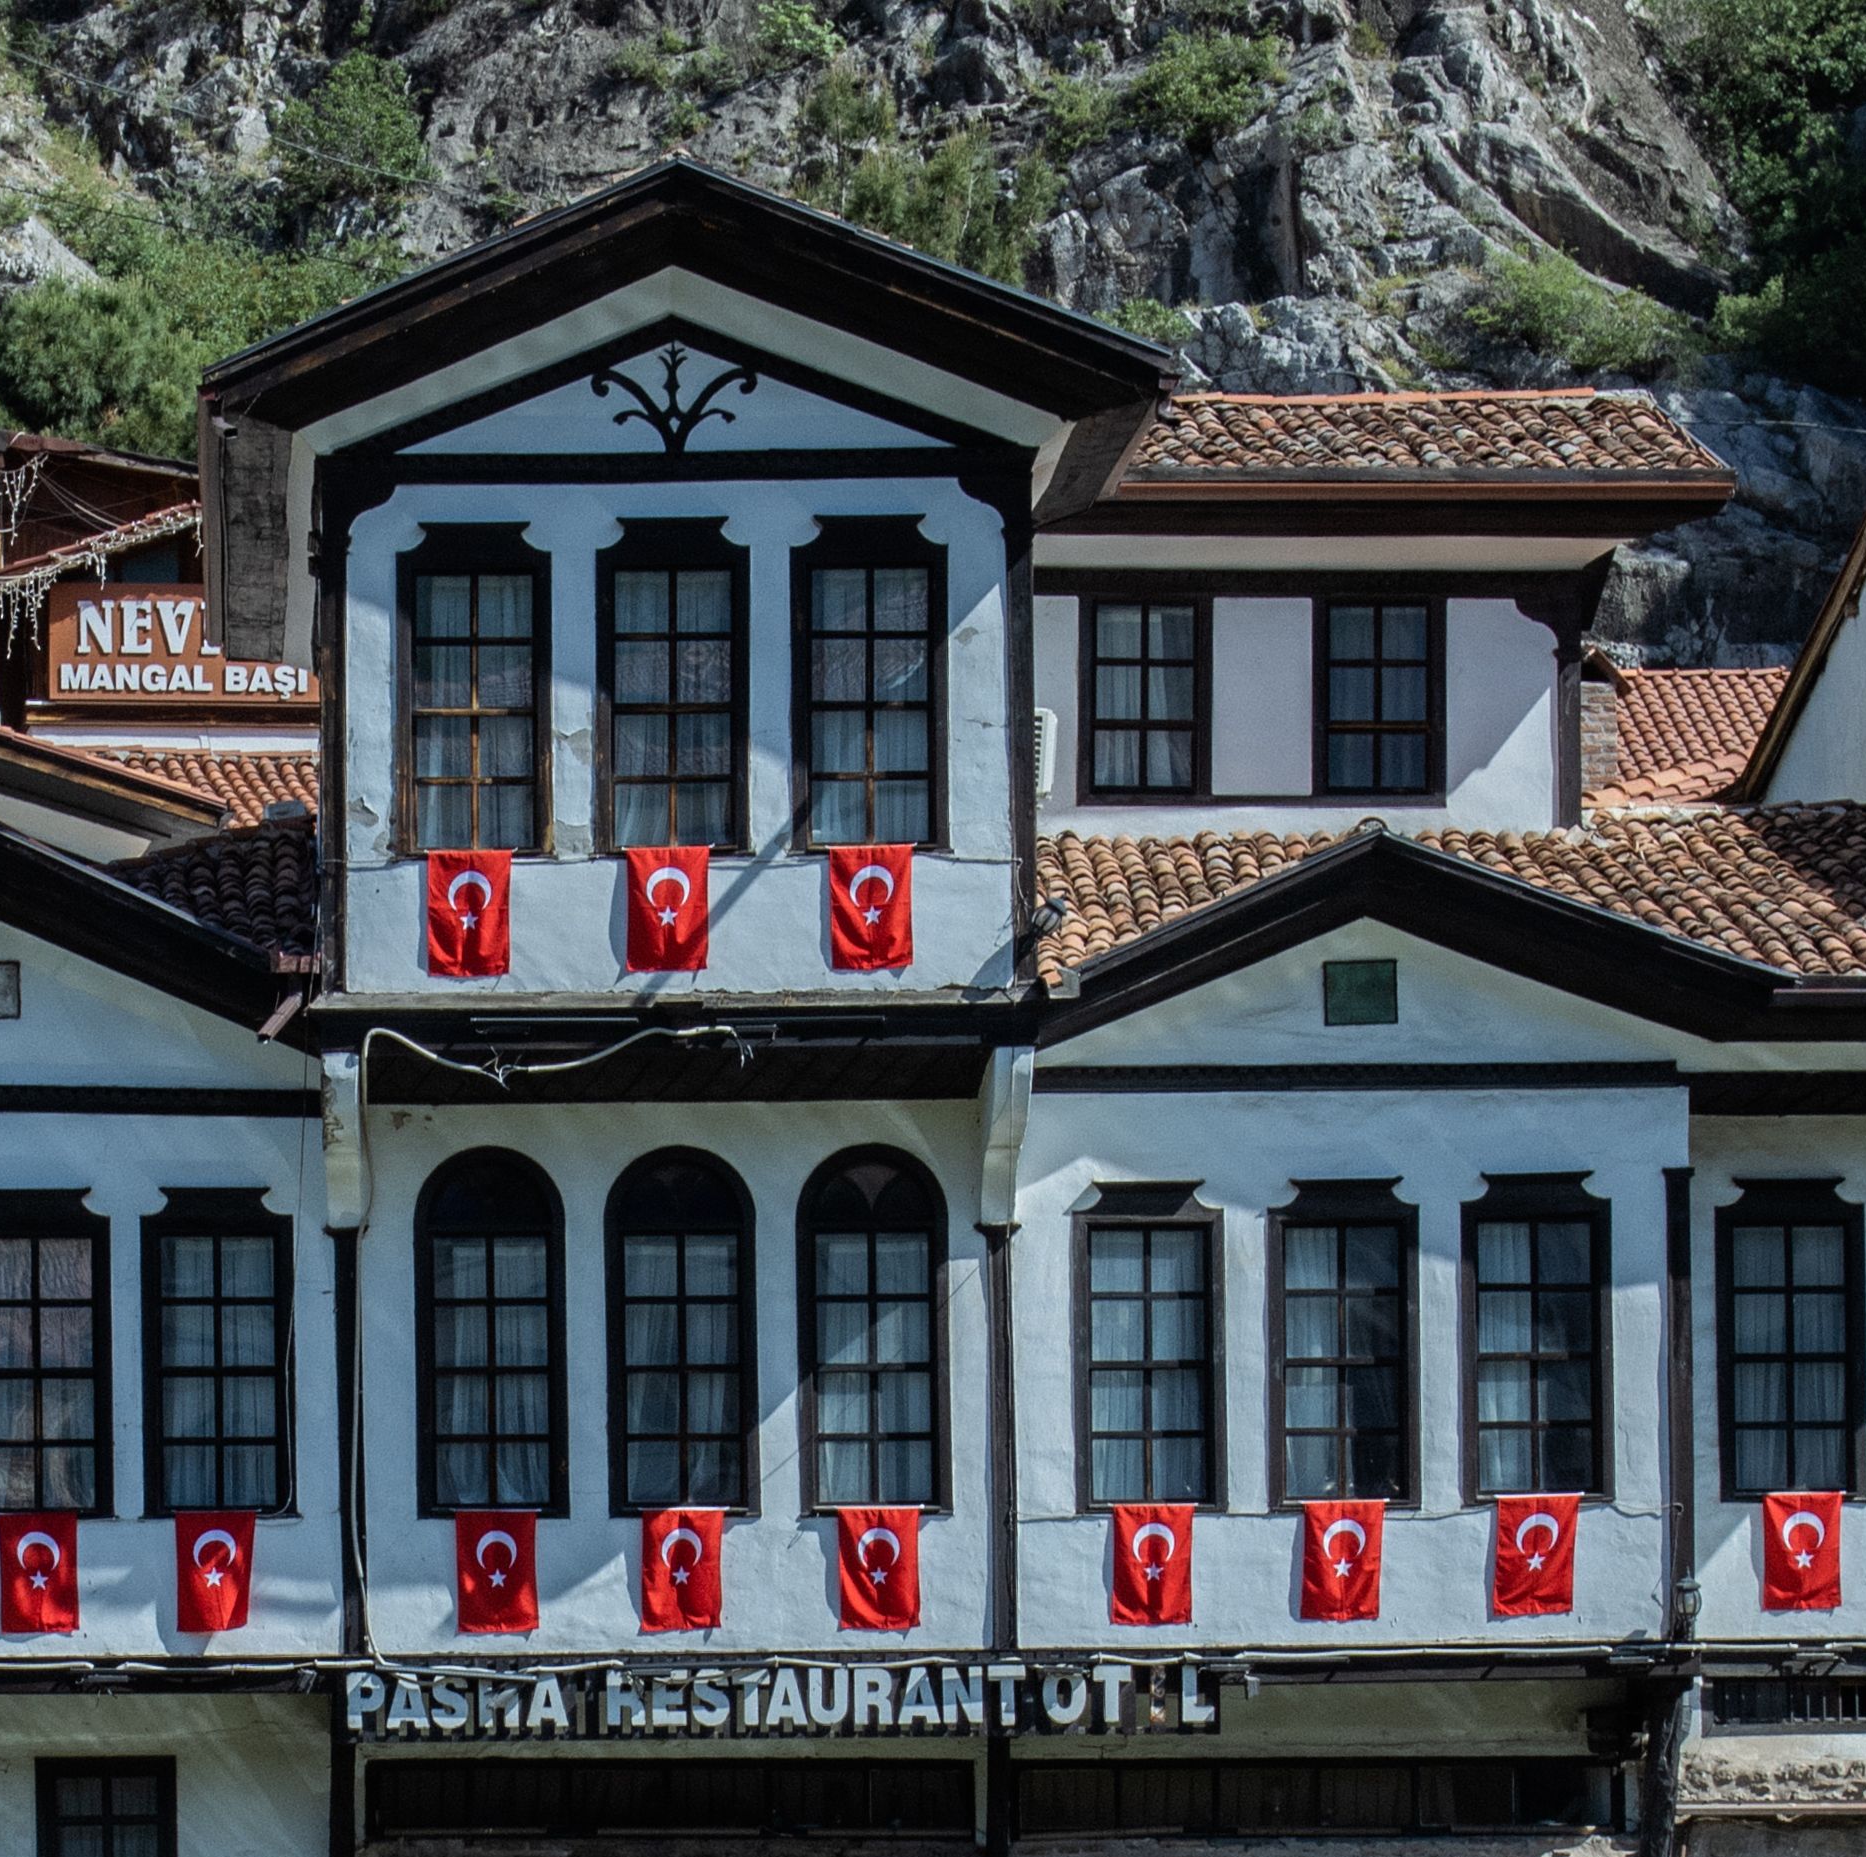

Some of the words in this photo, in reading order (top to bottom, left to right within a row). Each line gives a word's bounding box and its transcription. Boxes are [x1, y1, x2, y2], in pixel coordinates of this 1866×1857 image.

[77, 600, 222, 655] NEV
[60, 664, 213, 692] MANGAL
[225, 665, 308, 700] BAŞI
[346, 1670, 569, 1730] PASHA
[606, 1664, 1026, 1727] RESTAURANT
